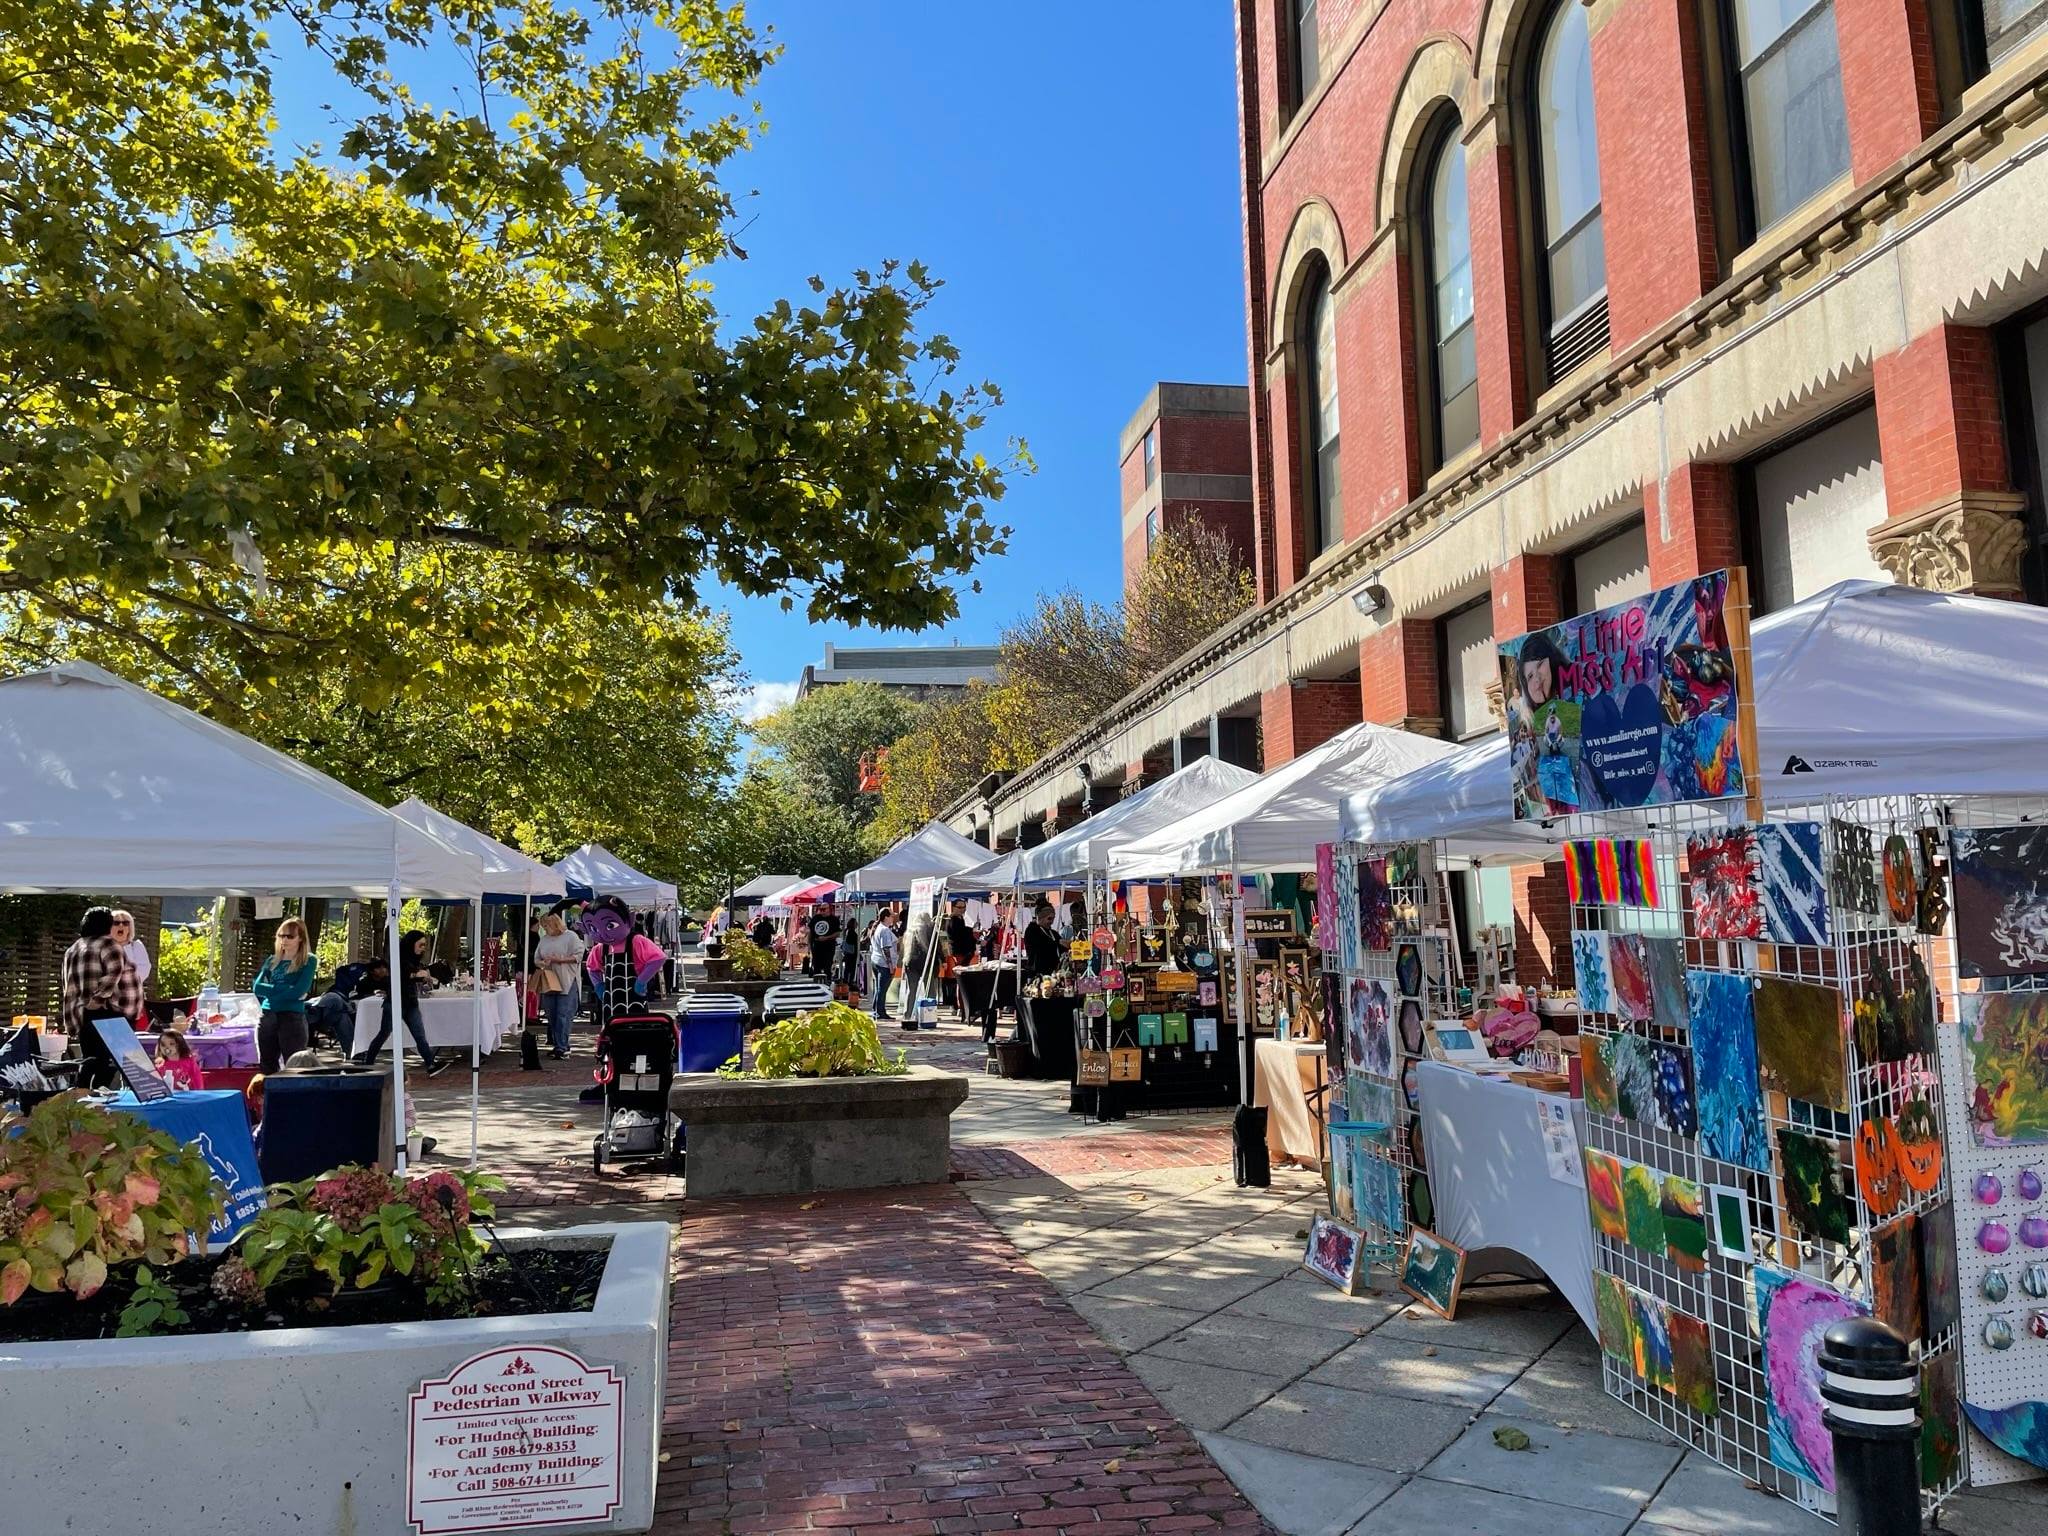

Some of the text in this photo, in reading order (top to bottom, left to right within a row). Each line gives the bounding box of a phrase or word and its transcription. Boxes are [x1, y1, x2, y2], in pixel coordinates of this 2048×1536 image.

[1082, 1062, 1107, 1073] Enloe
[452, 1377, 584, 1396] Old Second Street
[433, 1390, 601, 1412] Pedestrian Walkway
[457, 1413, 577, 1429] Limited Vehicle Access:
[471, 1431, 527, 1444] Hudner
[533, 1424, 598, 1439] Building:
[457, 1440, 576, 1460] Call 508-679-8353
[464, 1462, 533, 1477] Academy
[538, 1455, 604, 1471] Building:
[456, 1472, 575, 1492] Call 508-674-1111
